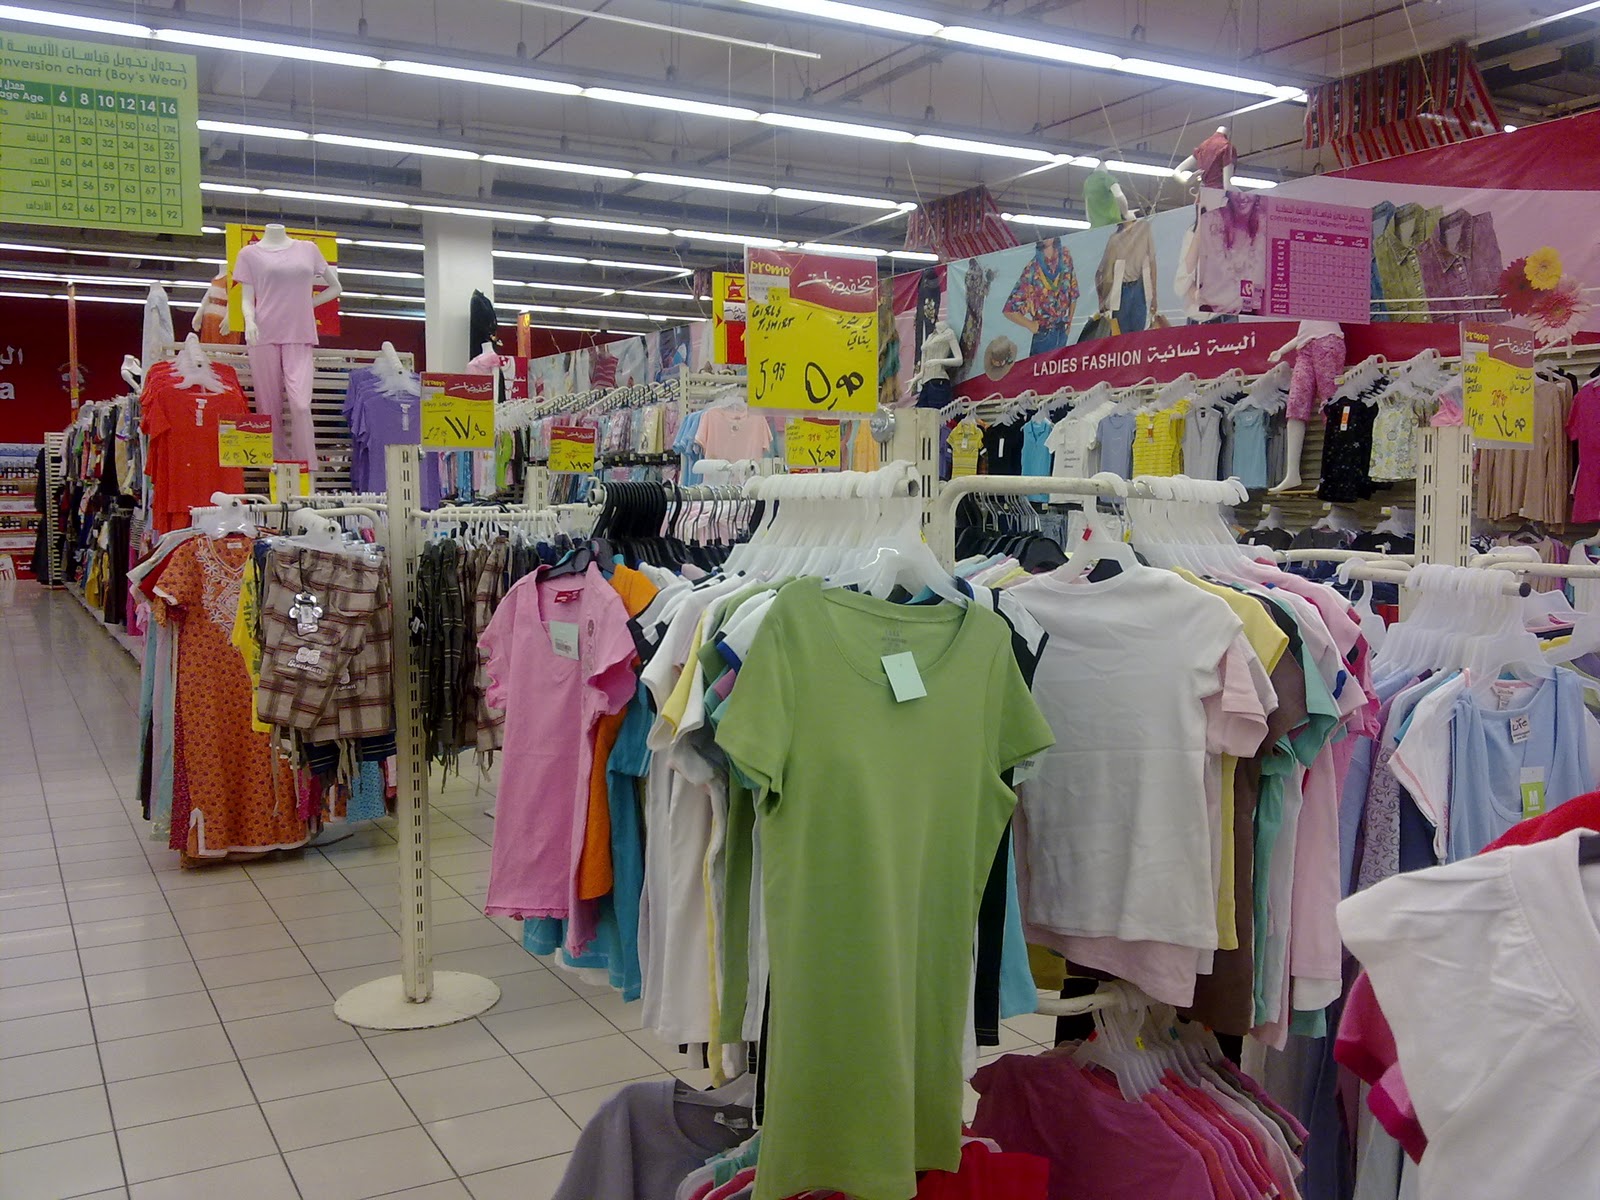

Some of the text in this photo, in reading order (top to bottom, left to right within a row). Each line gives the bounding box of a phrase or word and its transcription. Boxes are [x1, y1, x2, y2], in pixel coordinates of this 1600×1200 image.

[66, 64, 101, 78] chart
[150, 73, 188, 90] Wear)
[22, 91, 44, 104] Age
[59, 91, 176, 114] 6 8 10 12 14 16
[1147, 331, 1256, 363] ألبسة نسائية
[1033, 349, 1141, 377] LADIES FASHION
